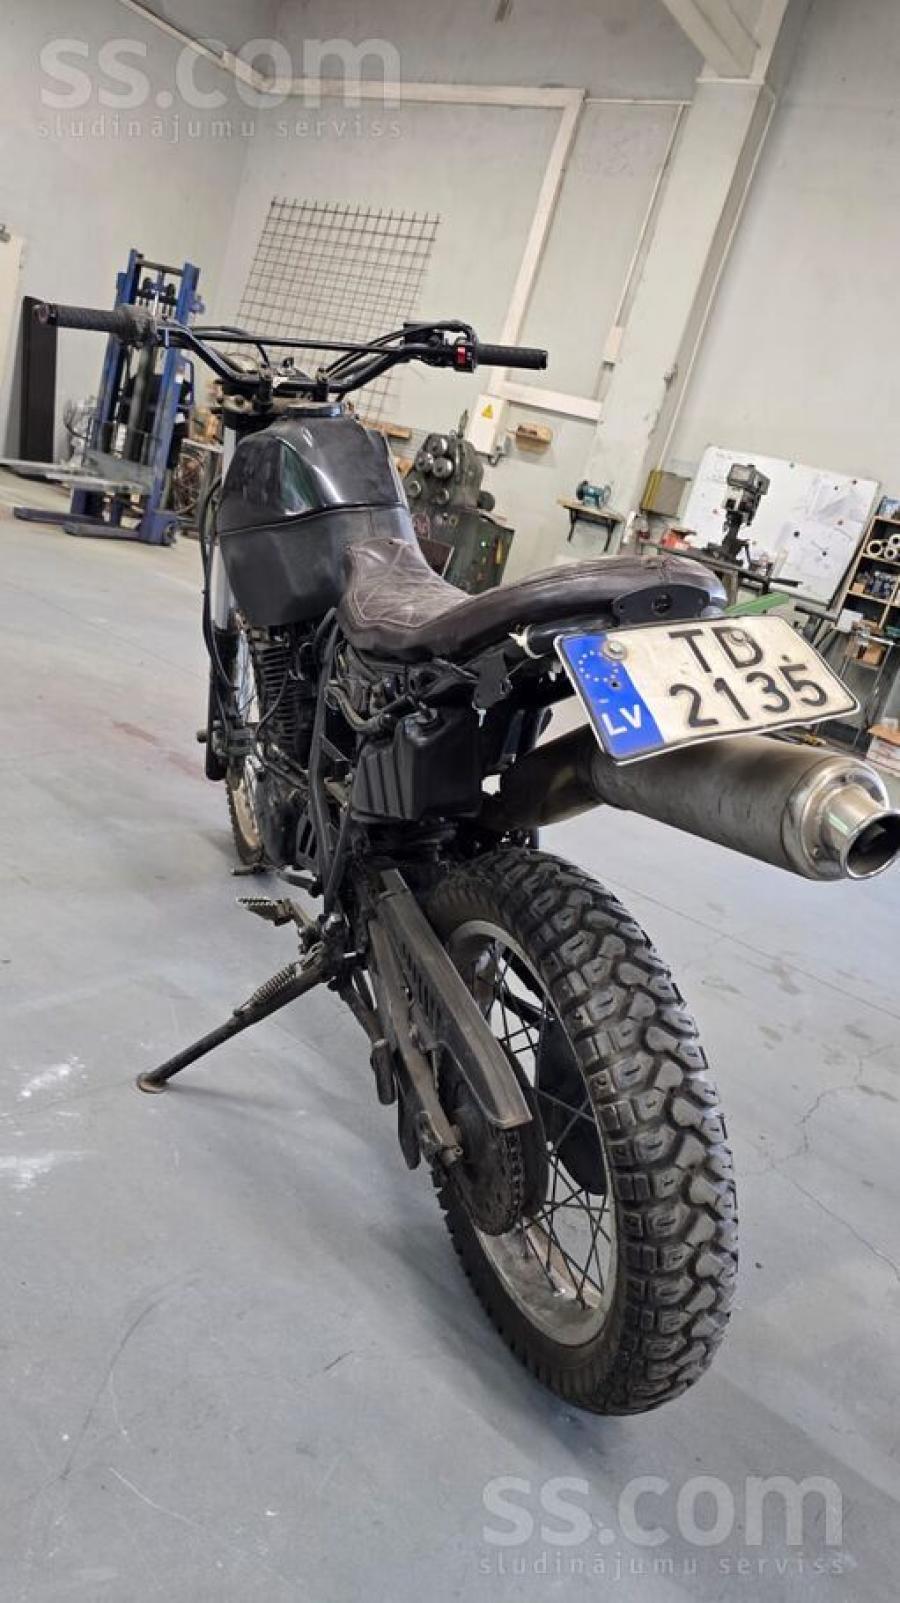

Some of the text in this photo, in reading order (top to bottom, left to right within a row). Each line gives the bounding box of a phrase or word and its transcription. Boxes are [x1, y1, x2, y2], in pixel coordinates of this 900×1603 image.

[668, 627, 763, 674] TD
[669, 664, 828, 728] 2135
[601, 704, 642, 736] LV
